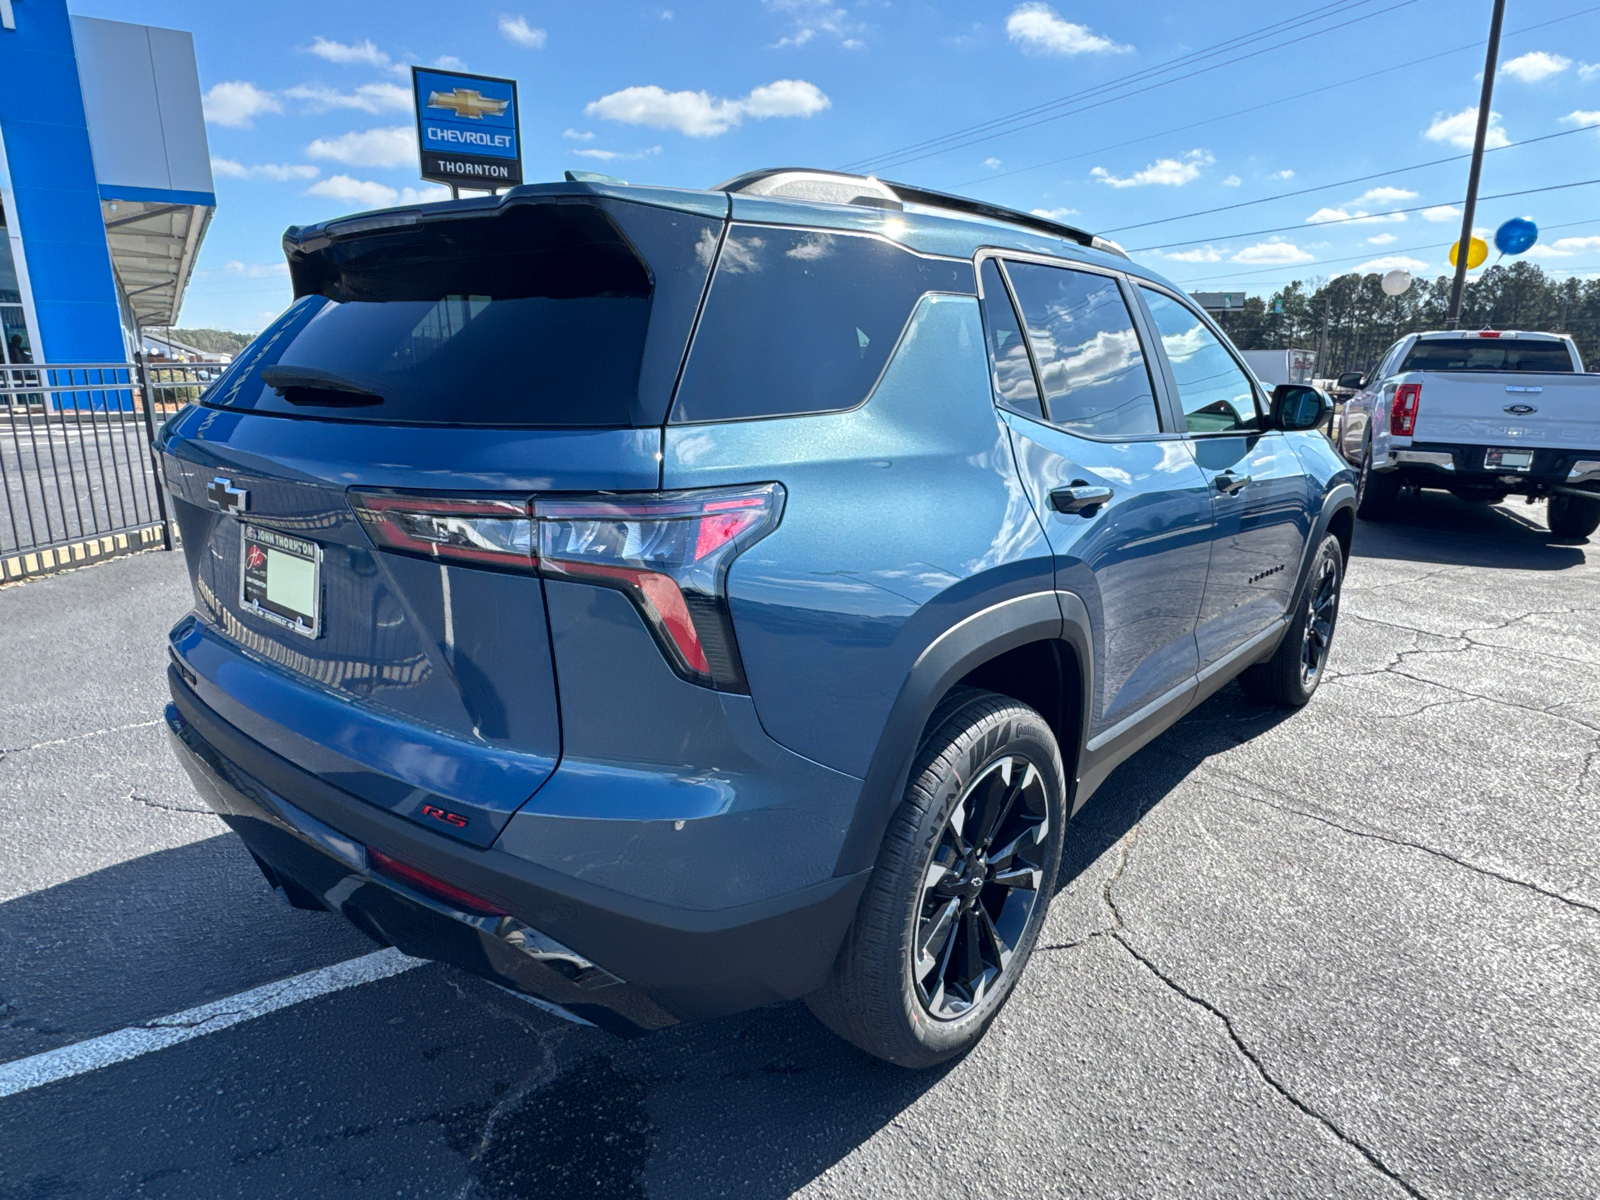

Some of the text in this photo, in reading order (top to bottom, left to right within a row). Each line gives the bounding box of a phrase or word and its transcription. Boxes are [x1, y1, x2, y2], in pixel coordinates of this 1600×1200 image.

[427, 127, 512, 148] CHEVROLET
[438, 160, 508, 178] THORNTON
[257, 529, 274, 544] JOHN
[422, 804, 469, 828] RS
